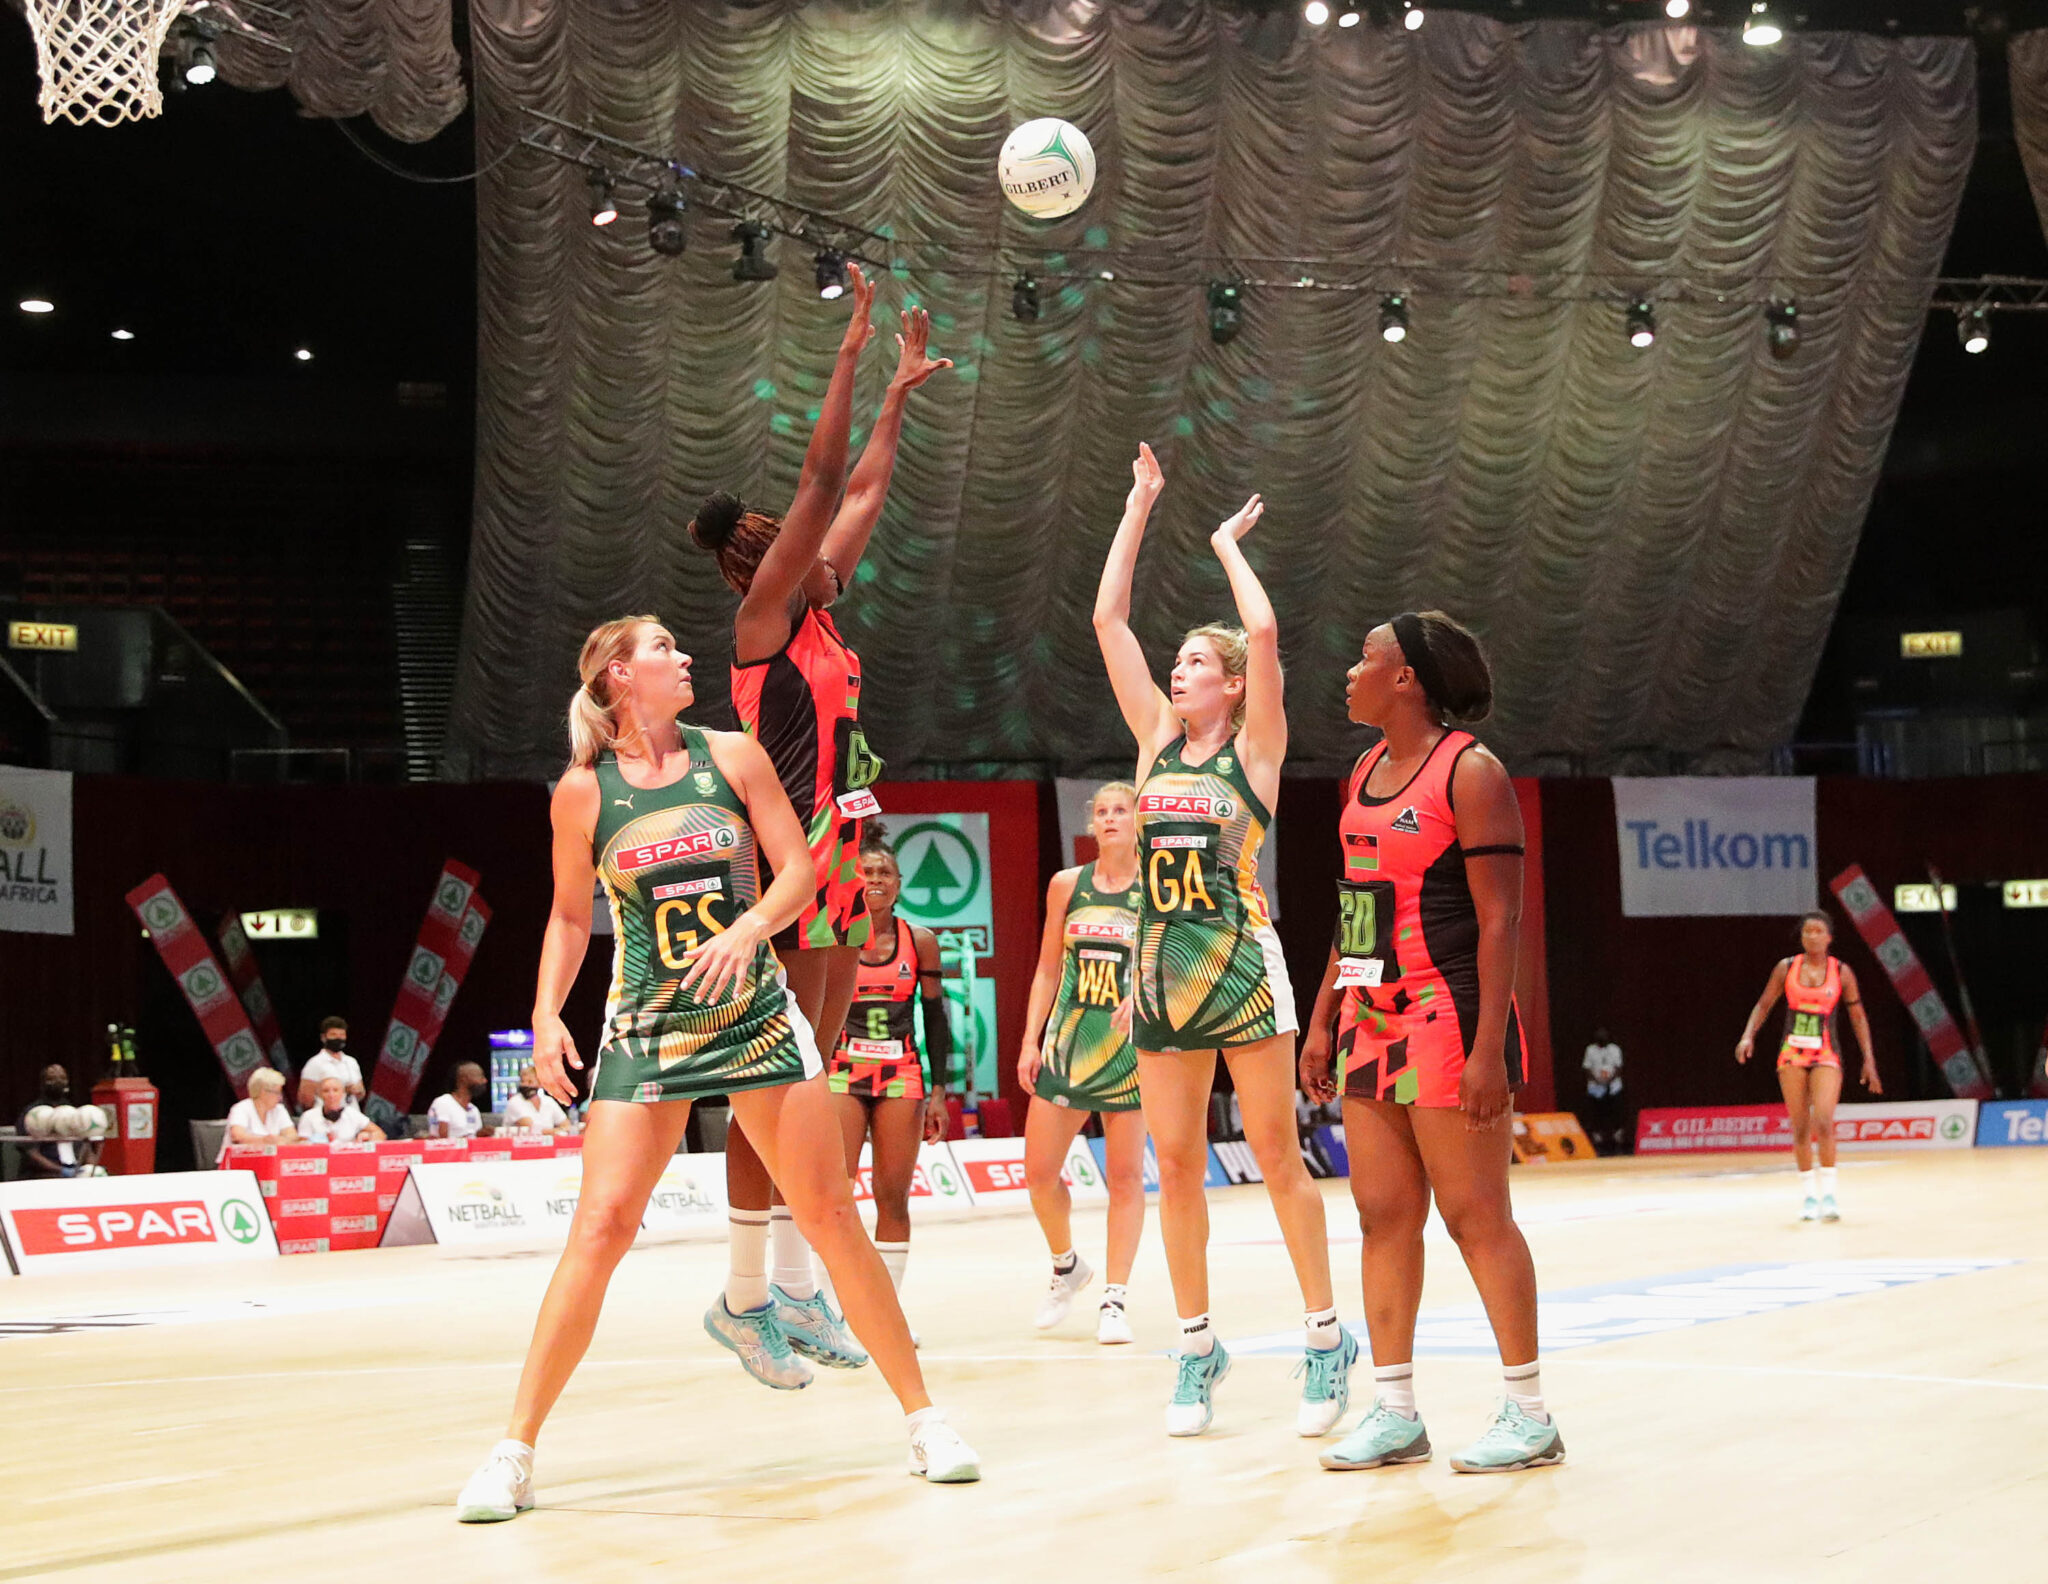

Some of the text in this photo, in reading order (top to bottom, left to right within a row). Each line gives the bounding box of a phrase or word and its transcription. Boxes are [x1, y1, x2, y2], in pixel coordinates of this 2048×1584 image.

[1005, 171, 1069, 195] GILBERT
[18, 626, 70, 646] EXIT
[853, 795, 876, 810] SPA
[1147, 797, 1209, 813] SPAR
[636, 836, 711, 864] SPAR
[1159, 838, 1192, 847] SPAR
[1626, 820, 1809, 869] Telkom
[665, 881, 705, 896] SPAR
[1149, 849, 1216, 913] GA
[1901, 889, 1949, 908] EXI
[655, 892, 728, 970] GS
[1078, 925, 1123, 937] SPAR
[1078, 959, 1121, 1008] WA
[1672, 1117, 1768, 1134] GILBERT
[1835, 1120, 1933, 1140] SPAR
[651, 1192, 714, 1208] NETBALL
[448, 1203, 522, 1222] NETBALL
[58, 1207, 212, 1245] SPAR
[1184, 1322, 1208, 1334] PUMA
